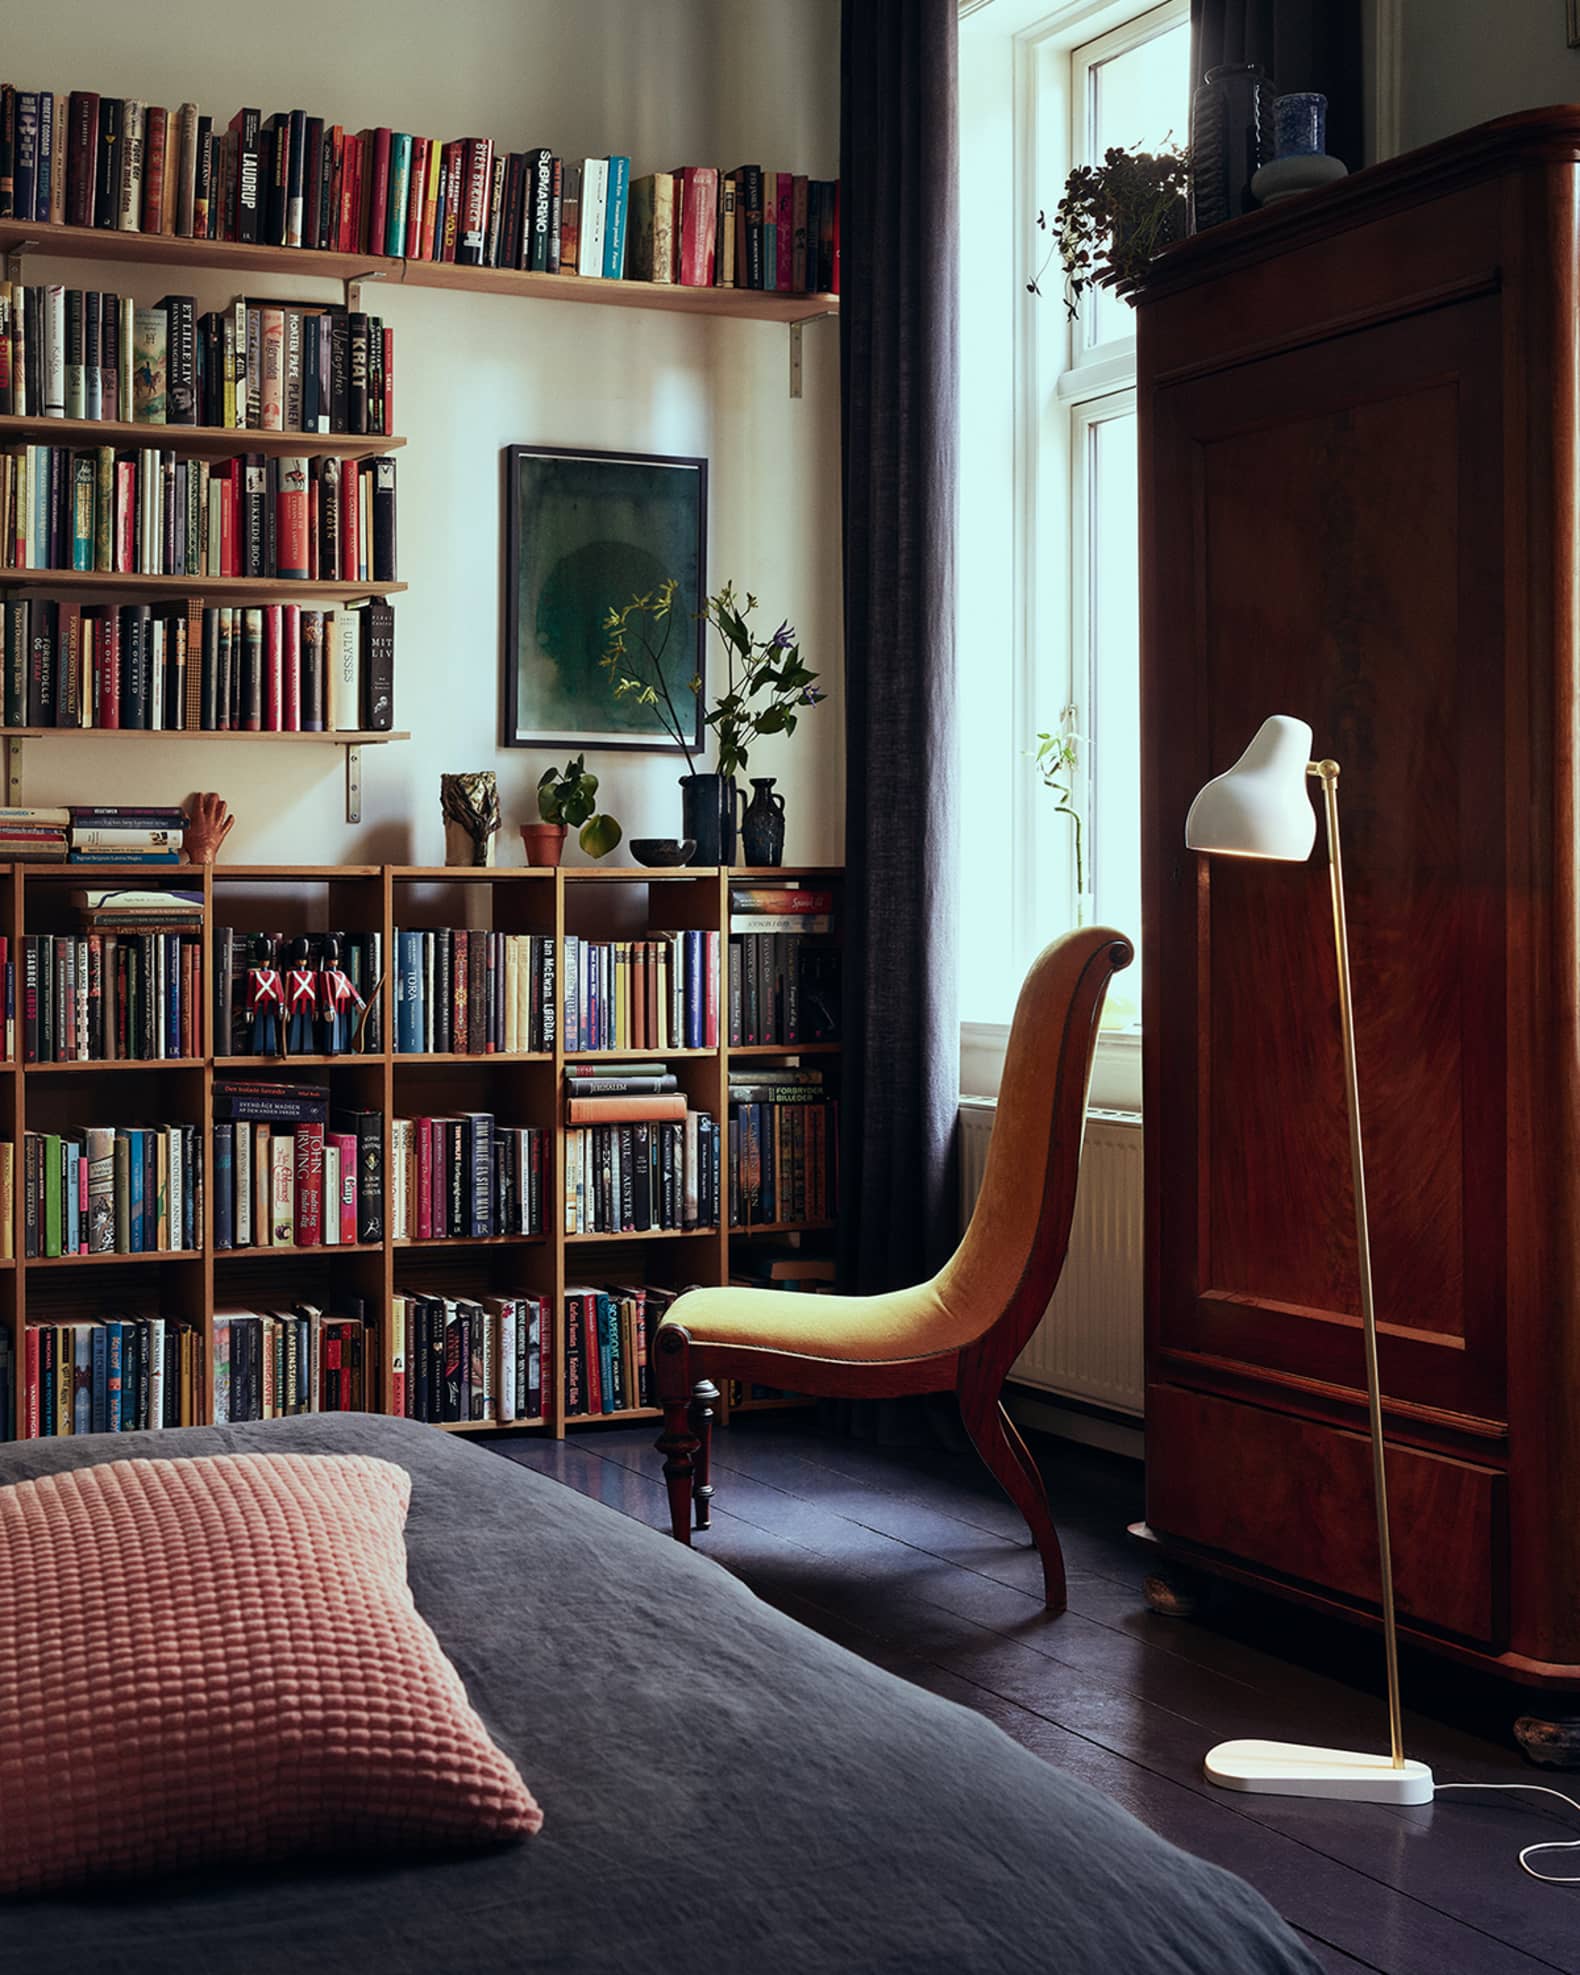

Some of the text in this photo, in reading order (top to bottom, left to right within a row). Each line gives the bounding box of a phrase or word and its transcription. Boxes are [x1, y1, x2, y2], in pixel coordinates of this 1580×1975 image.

[474, 143, 488, 170] BYEN
[241, 152, 258, 209] LAUDRUP
[536, 150, 551, 233] SUBMARINO
[182, 304, 192, 385] ET LILLE LIV
[352, 337, 366, 390] KRAT
[288, 314, 299, 424] MORTEN PAPE PLANEN
[251, 494, 260, 542] LUKKEDE
[34, 638, 42, 650] OG
[104, 650, 110, 663] OG
[132, 650, 138, 664] OG
[344, 632, 353, 682] ULYSSES
[372, 638, 392, 647] MIT
[372, 650, 392, 658] LIV
[42, 638, 51, 704] FORBRYDELSE
[544, 940, 554, 956] Ian
[408, 970, 416, 1001] TORA
[544, 958, 555, 998] McEwan
[476, 1122, 488, 1137] TOM
[297, 1130, 310, 1180] IRVING
[311, 1135, 322, 1174] JOHN
[476, 1139, 488, 1163] WOLFE
[623, 1130, 633, 1219] PAUL AUSTER
[608, 1302, 620, 1359] SCAPEGOAT
